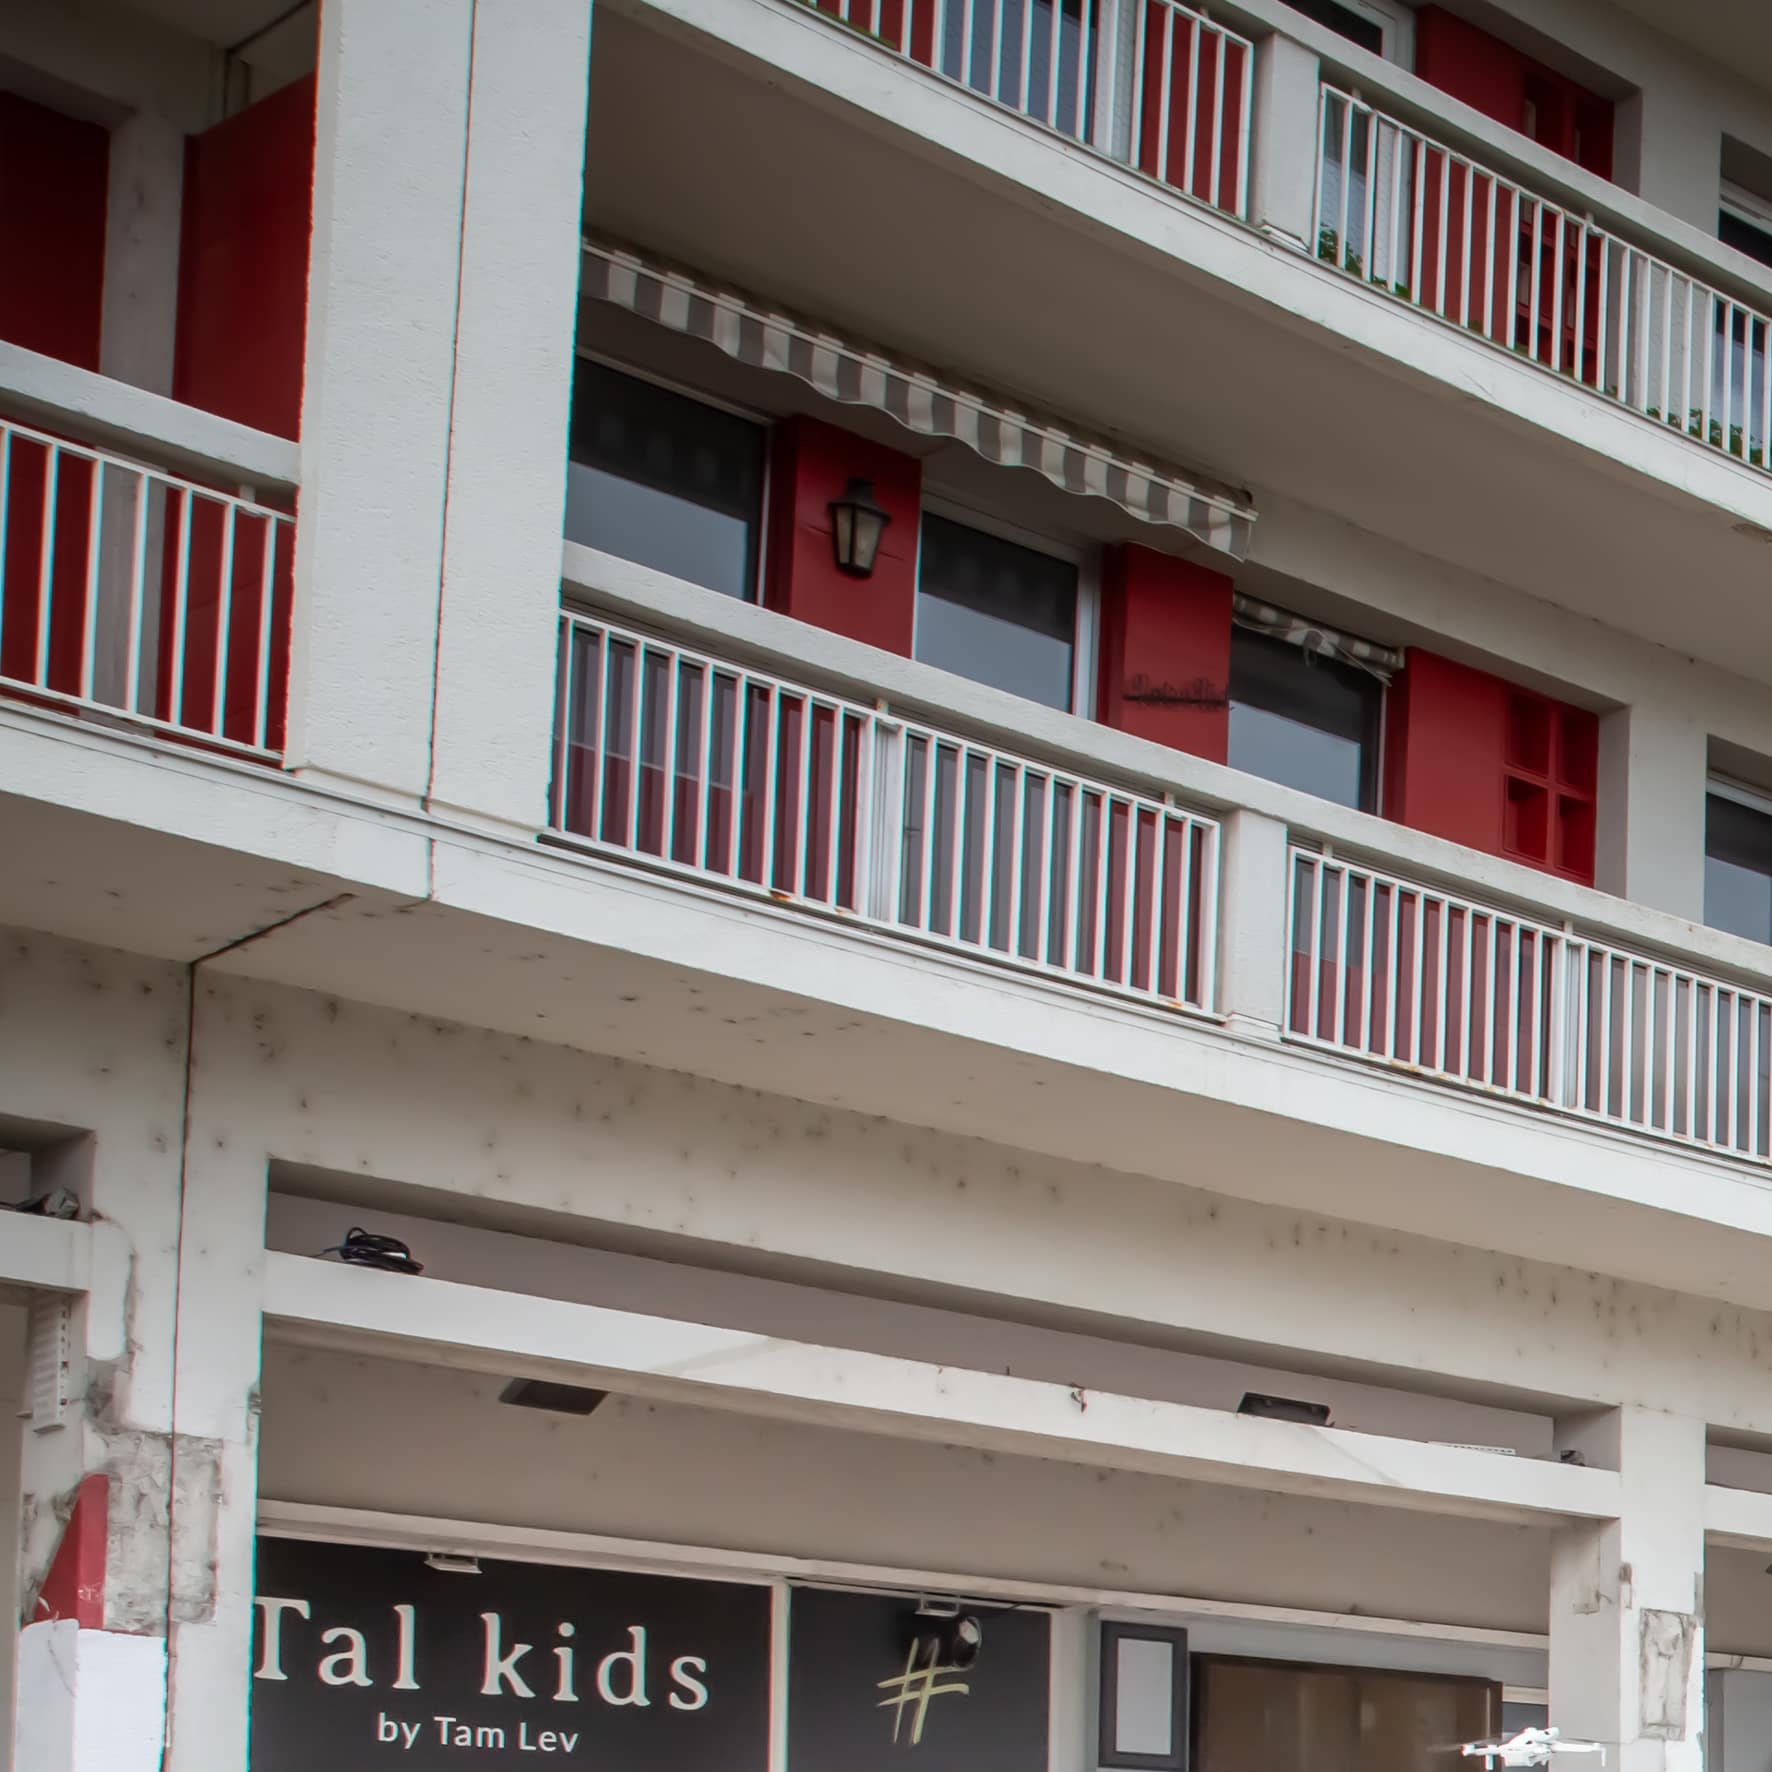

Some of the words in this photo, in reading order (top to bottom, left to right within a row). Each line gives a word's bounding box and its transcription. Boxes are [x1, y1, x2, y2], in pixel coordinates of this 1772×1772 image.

[253, 1596, 421, 1690] Tal
[480, 1611, 709, 1711] kids
[378, 1712, 422, 1749] by
[433, 1716, 505, 1749] Tam
[518, 1721, 580, 1753] Lev
